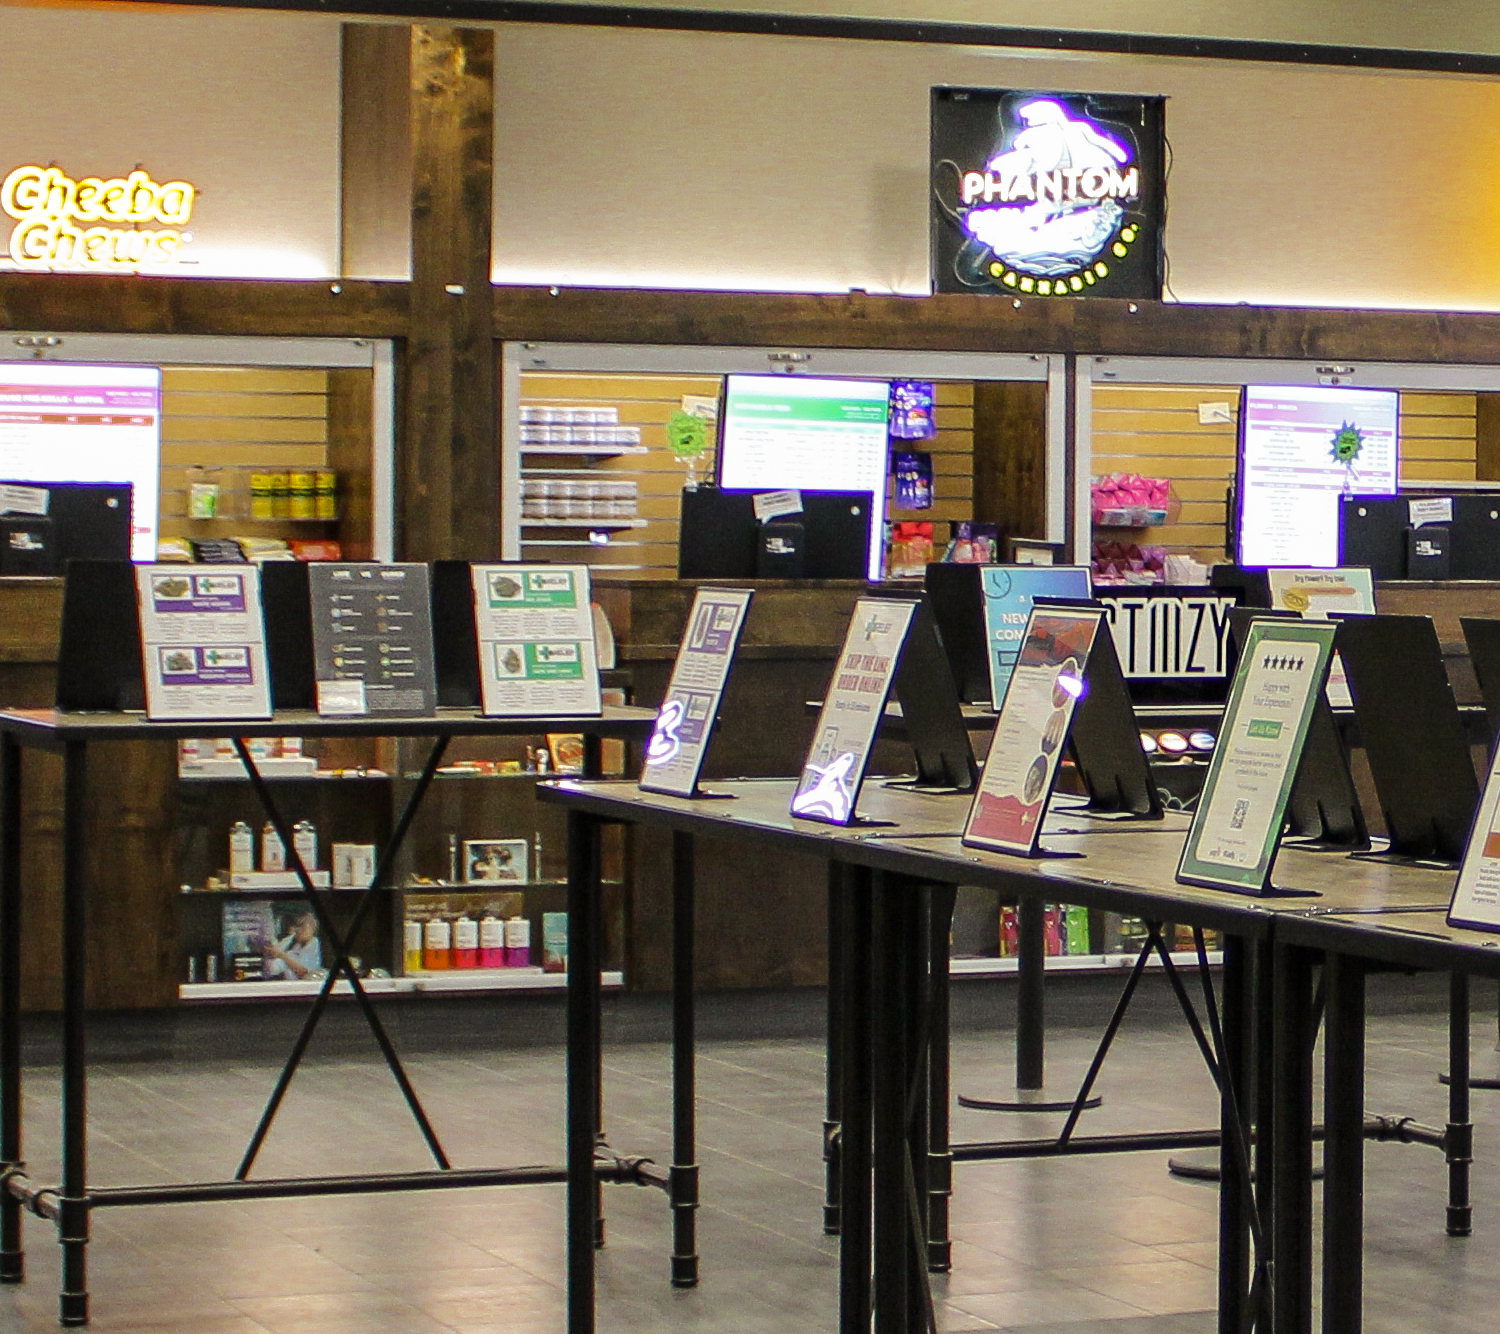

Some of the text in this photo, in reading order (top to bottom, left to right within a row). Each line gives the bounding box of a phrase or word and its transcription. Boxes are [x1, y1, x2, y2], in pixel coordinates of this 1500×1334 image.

[1, 166, 195, 224] Cheeba
[962, 165, 1140, 205] PHANTOM
[9, 218, 186, 267] Chews
